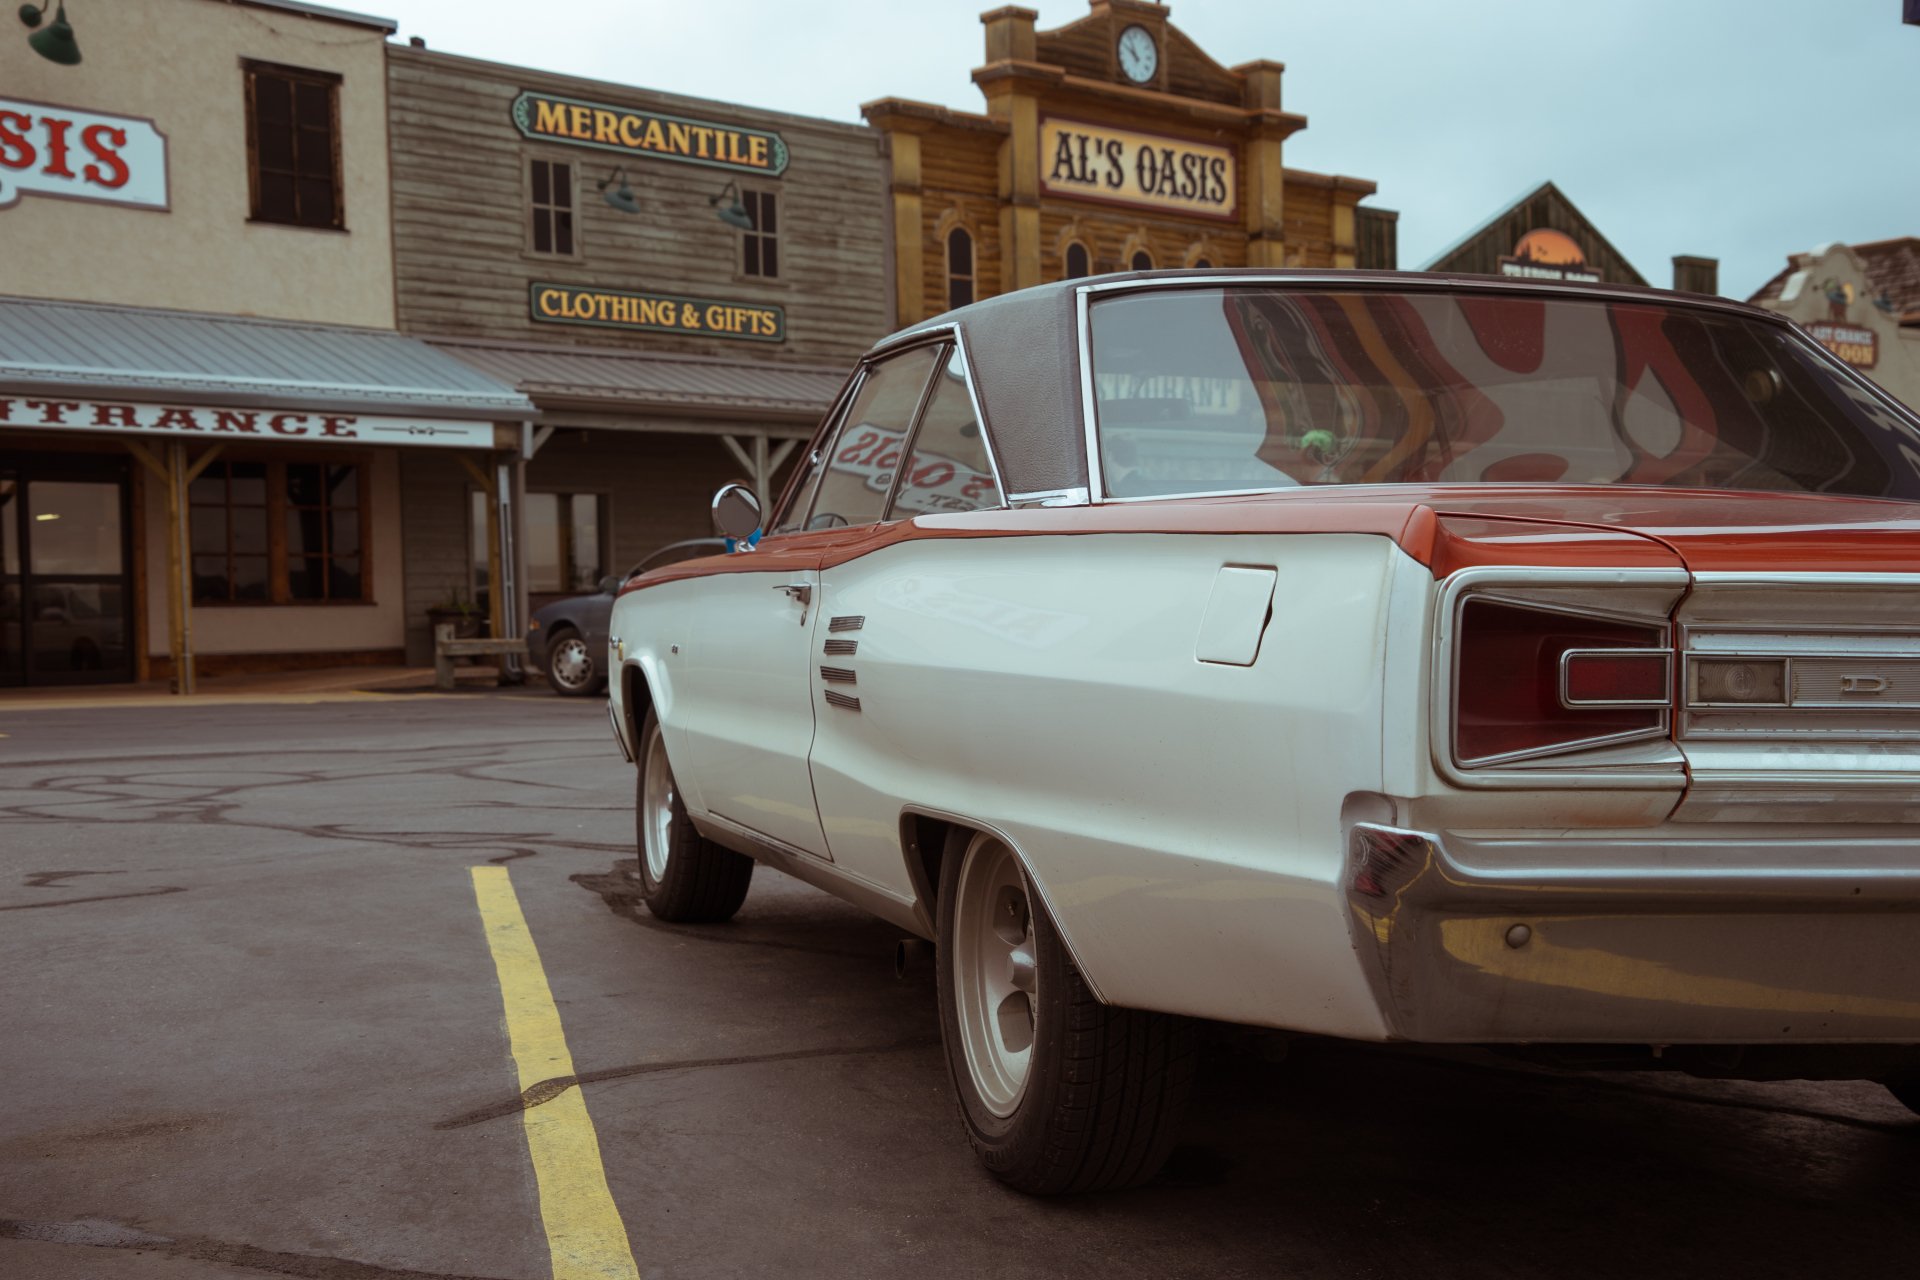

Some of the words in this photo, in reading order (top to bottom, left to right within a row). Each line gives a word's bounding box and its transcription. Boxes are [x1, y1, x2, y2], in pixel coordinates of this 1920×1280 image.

[0, 110, 130, 189] SIS
[535, 99, 768, 168] MERCANTILE
[1051, 131, 1124, 190] AL'S
[1136, 145, 1227, 205] OASIS
[539, 289, 676, 327] CLOTHING
[681, 303, 702, 329] &
[706, 305, 777, 336] GIFTS
